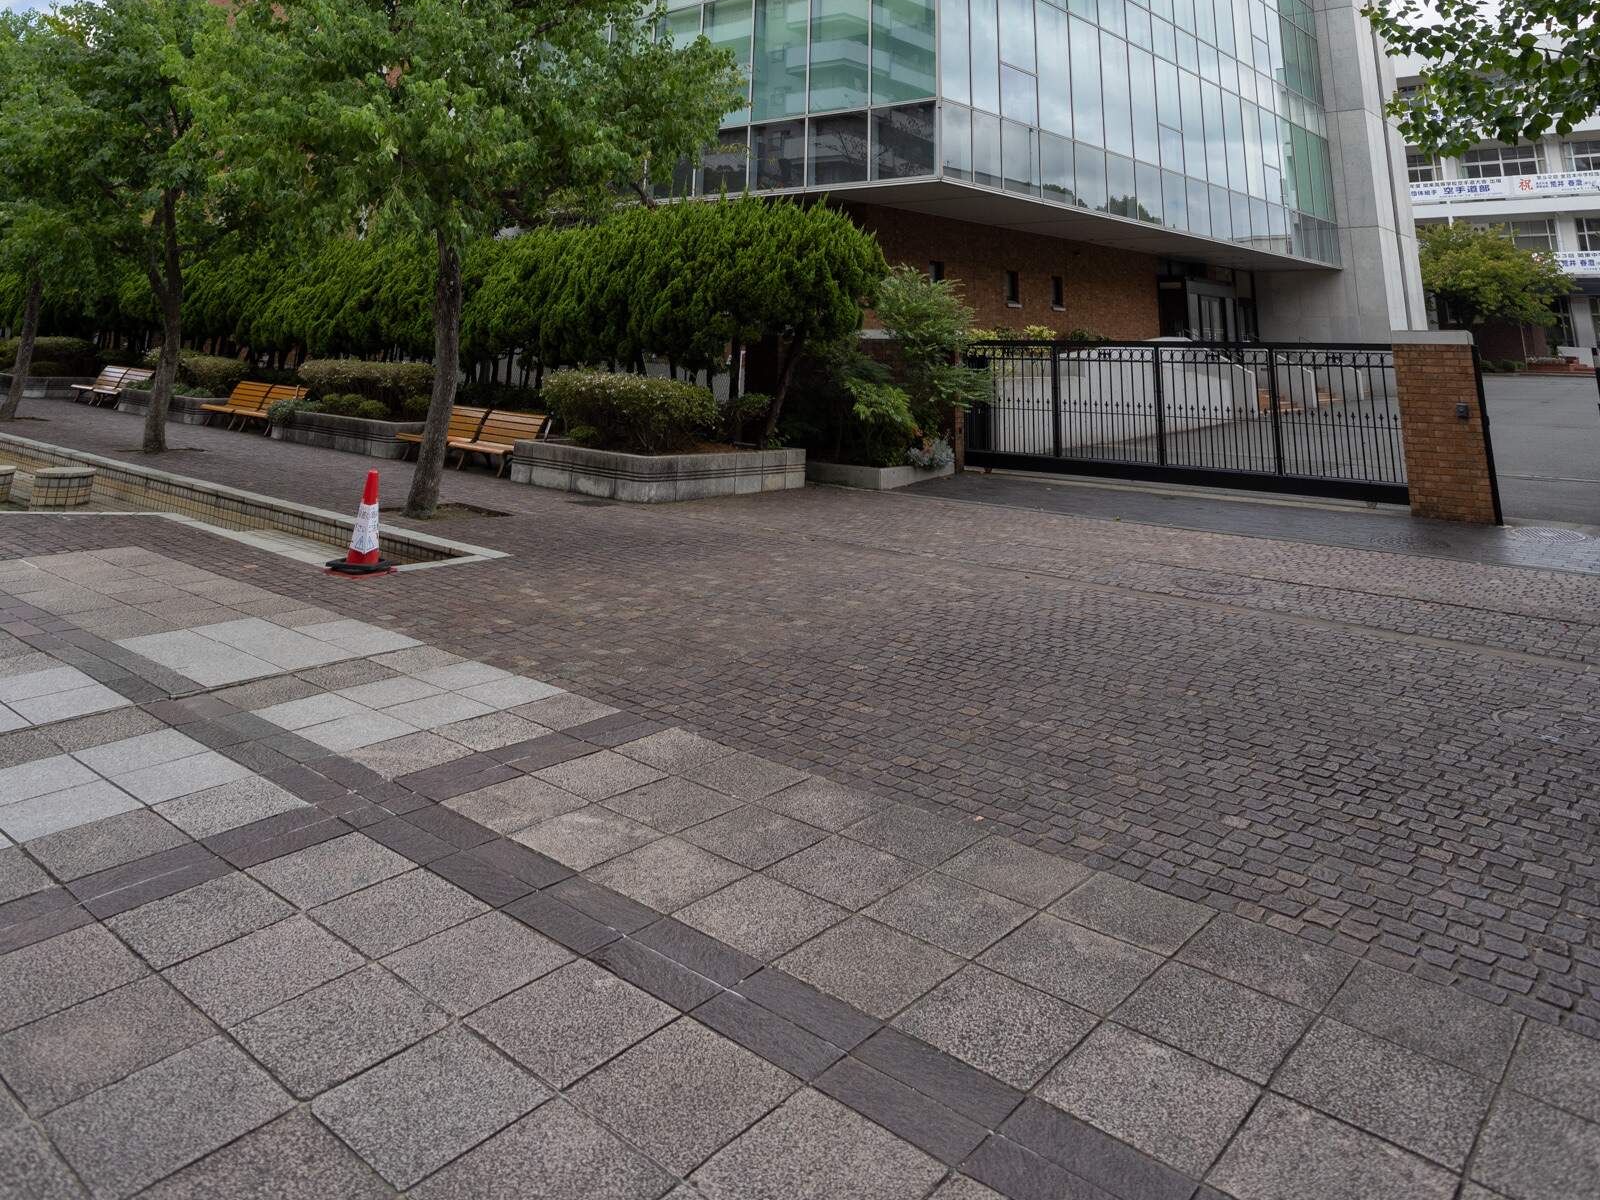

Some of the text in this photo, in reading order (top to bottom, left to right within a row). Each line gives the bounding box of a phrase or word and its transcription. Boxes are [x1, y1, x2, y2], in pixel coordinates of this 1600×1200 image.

[1443, 184, 1490, 194] 空手道部
[1519, 178, 1533, 191] 祝
